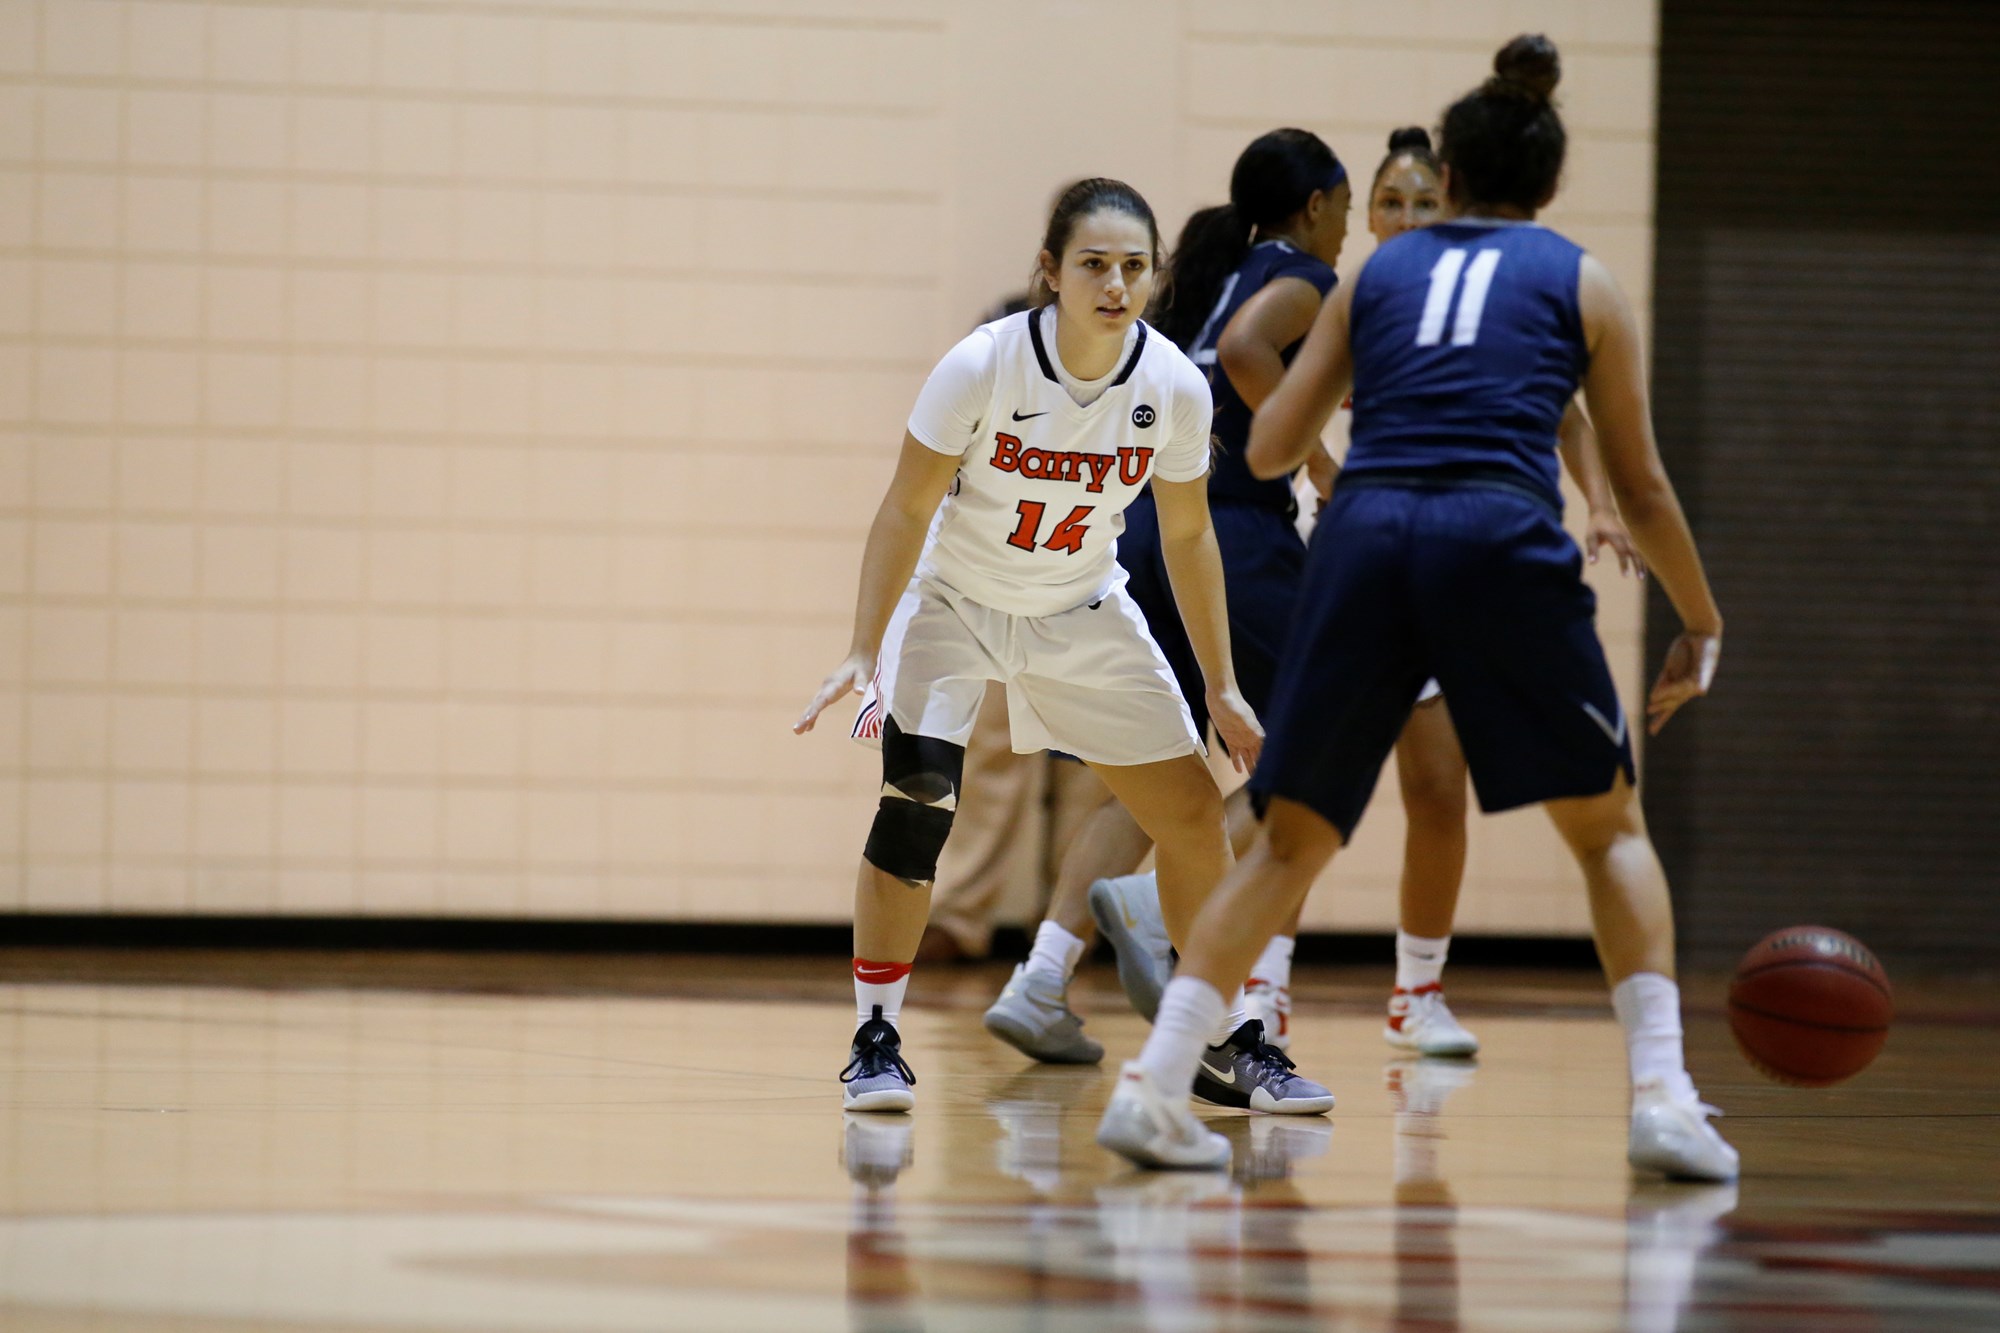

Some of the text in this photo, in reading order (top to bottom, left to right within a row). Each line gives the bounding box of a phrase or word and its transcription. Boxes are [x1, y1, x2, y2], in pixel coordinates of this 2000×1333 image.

[1415, 248, 1502, 346] 11
[1133, 410, 1155, 423] CO
[989, 432, 1154, 493] Barry U
[1006, 499, 1096, 556] 14
